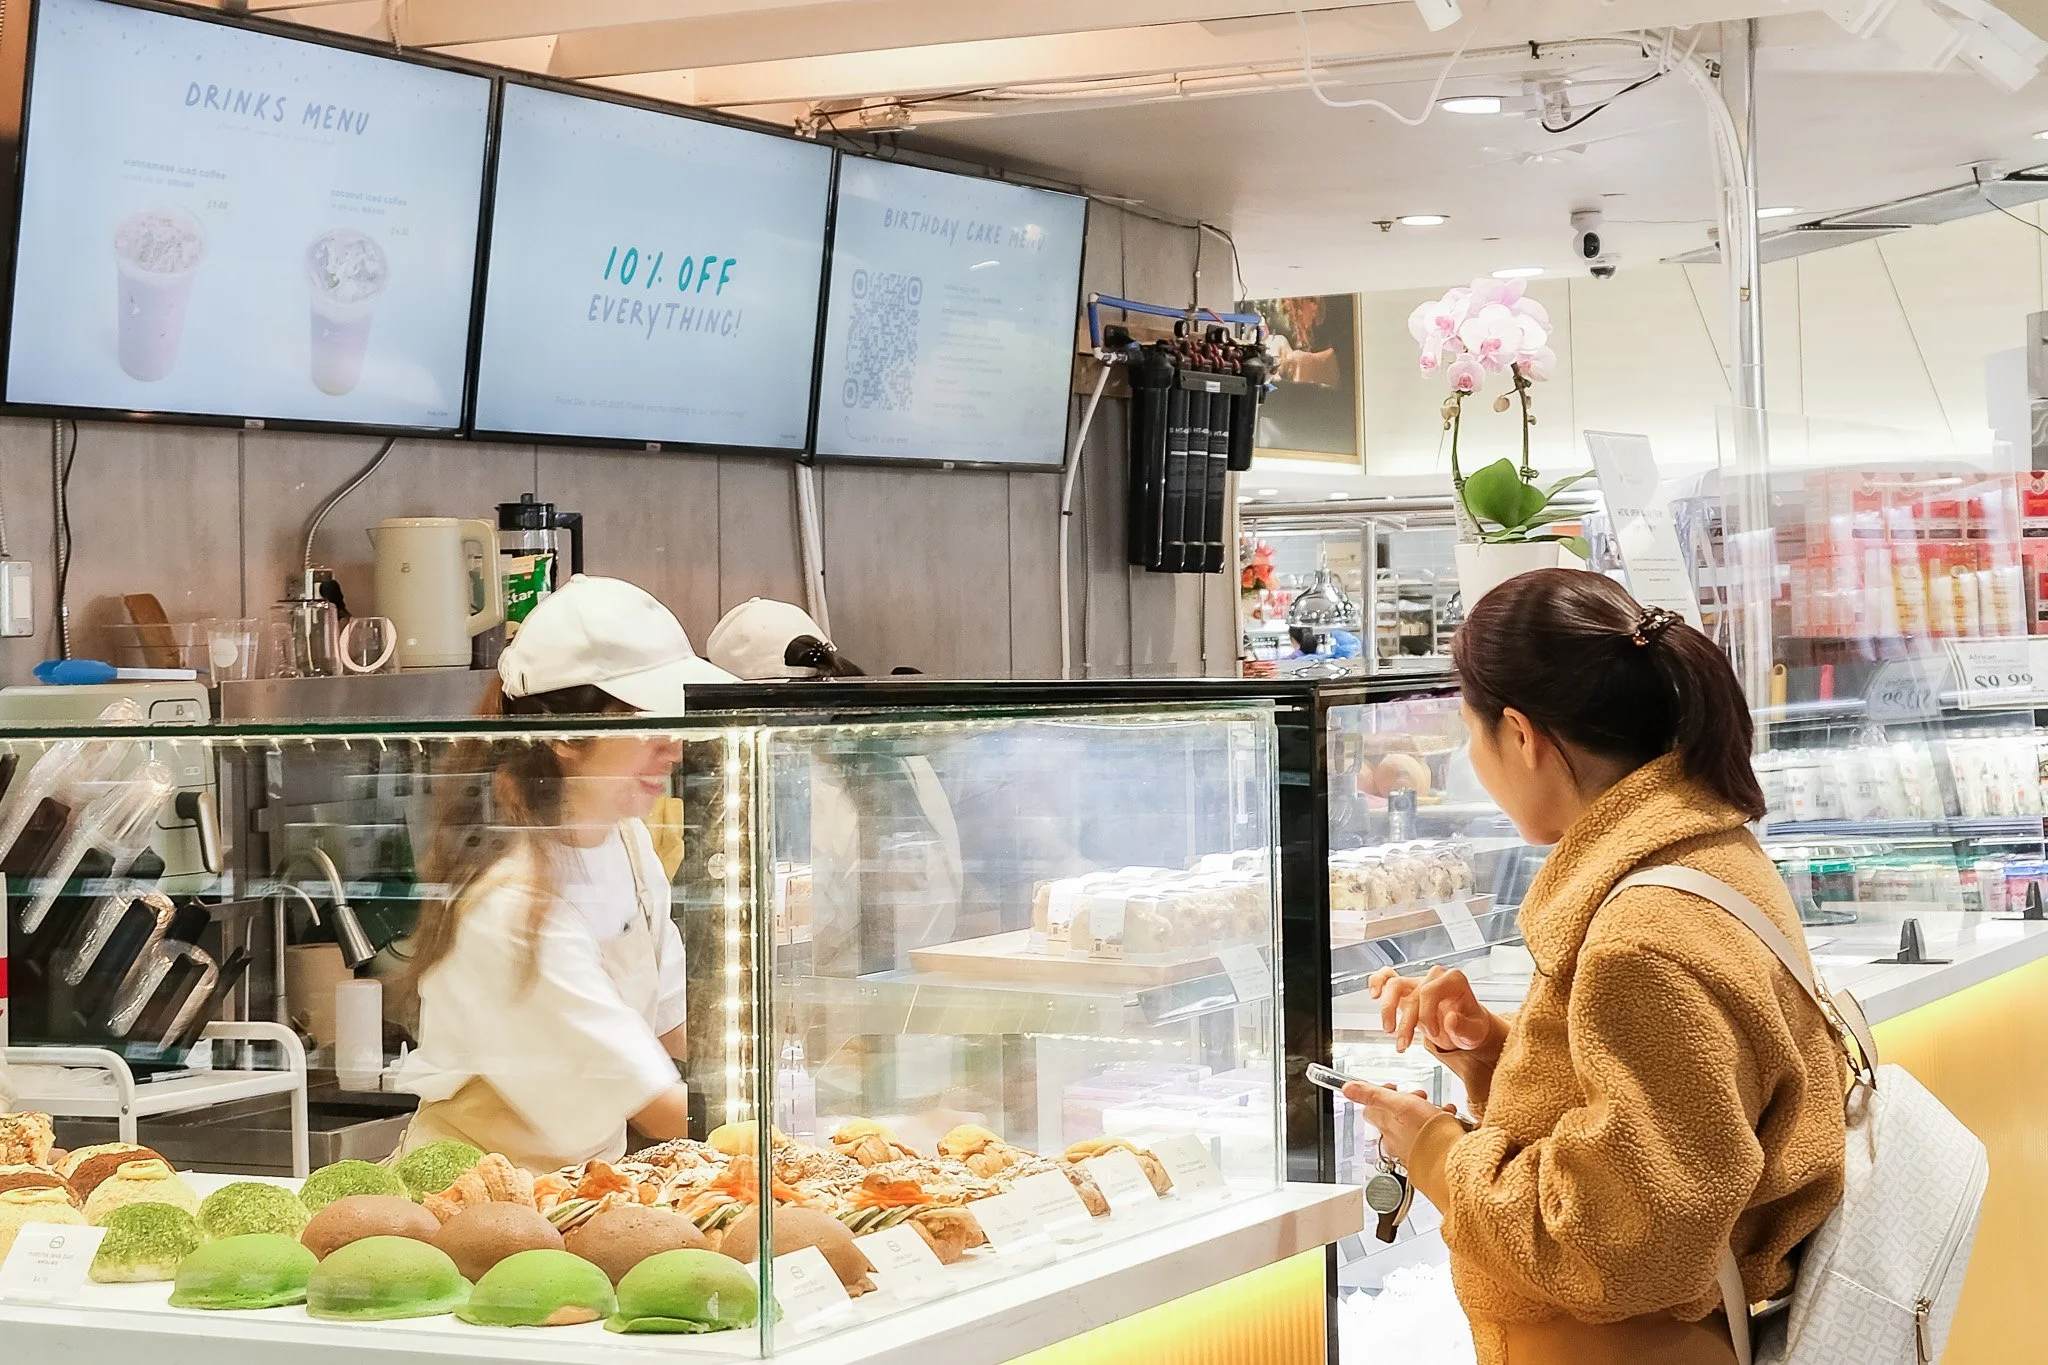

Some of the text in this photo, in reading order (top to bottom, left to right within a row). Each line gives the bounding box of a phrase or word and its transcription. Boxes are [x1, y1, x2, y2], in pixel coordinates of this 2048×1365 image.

[185, 81, 287, 123] DRINKS
[302, 102, 371, 136] MENU
[177, 166, 198, 176] iced
[199, 168, 227, 181] coffee
[330, 189, 363, 201] coconut
[383, 195, 408, 207] coffee
[883, 207, 960, 247] BIRTHDAY
[966, 221, 1003, 244] CAKE
[603, 245, 737, 296] 10% OFF
[587, 293, 743, 340] EVERYTHING!
